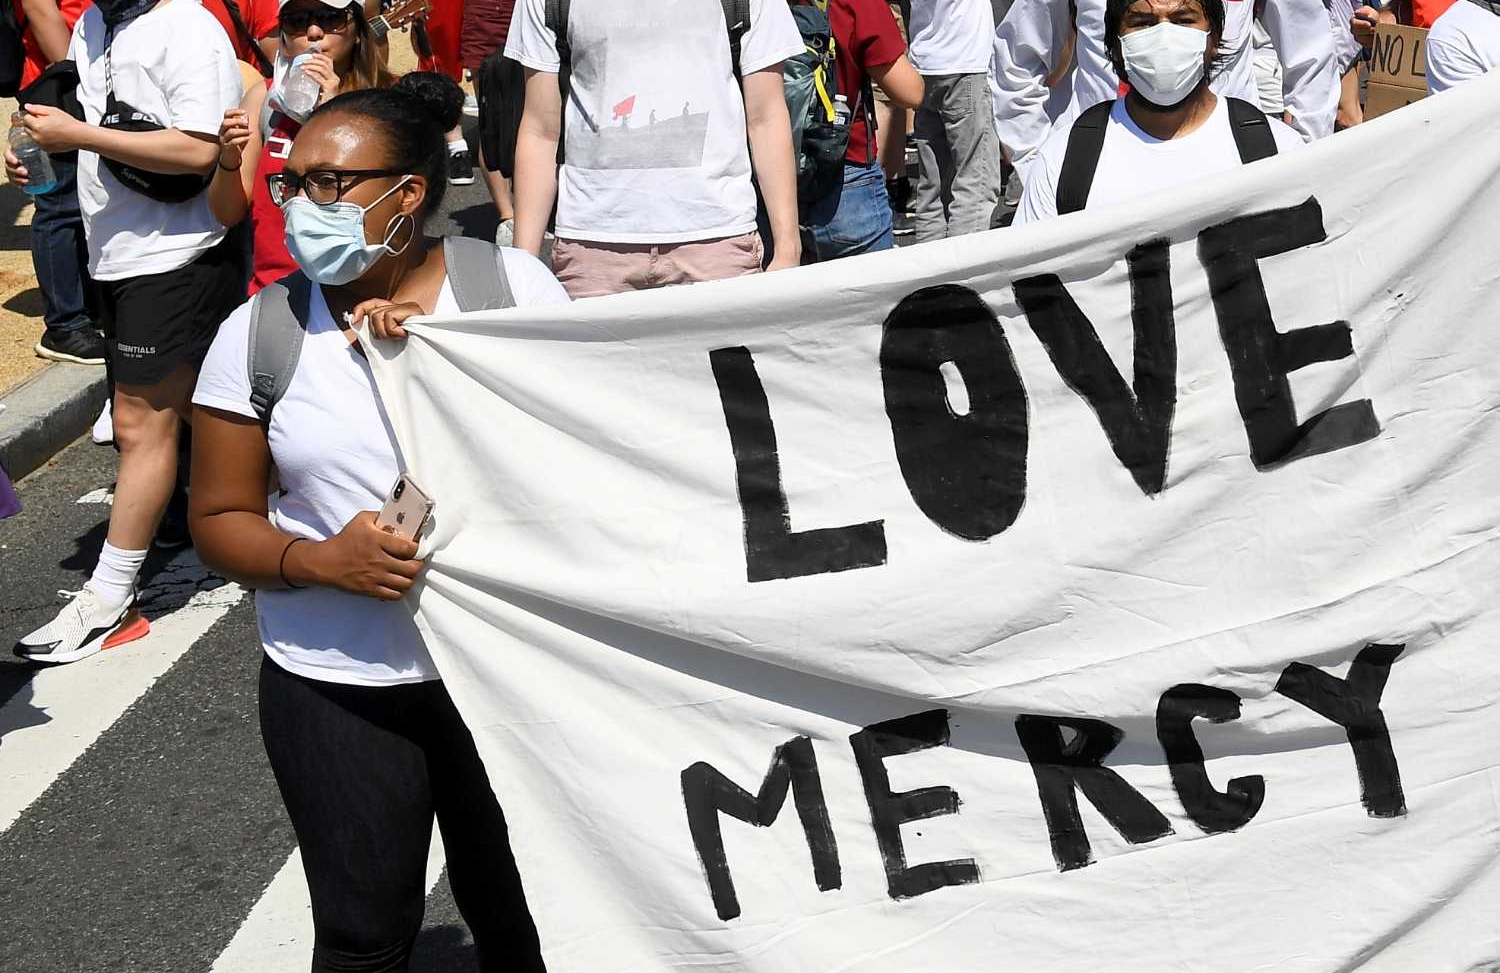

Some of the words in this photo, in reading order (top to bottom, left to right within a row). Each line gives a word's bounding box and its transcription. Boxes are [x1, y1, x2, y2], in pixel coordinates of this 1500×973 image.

[1371, 33, 1404, 76] NO
[710, 195, 1382, 583] LOVE
[680, 643, 1406, 921] MERCY
